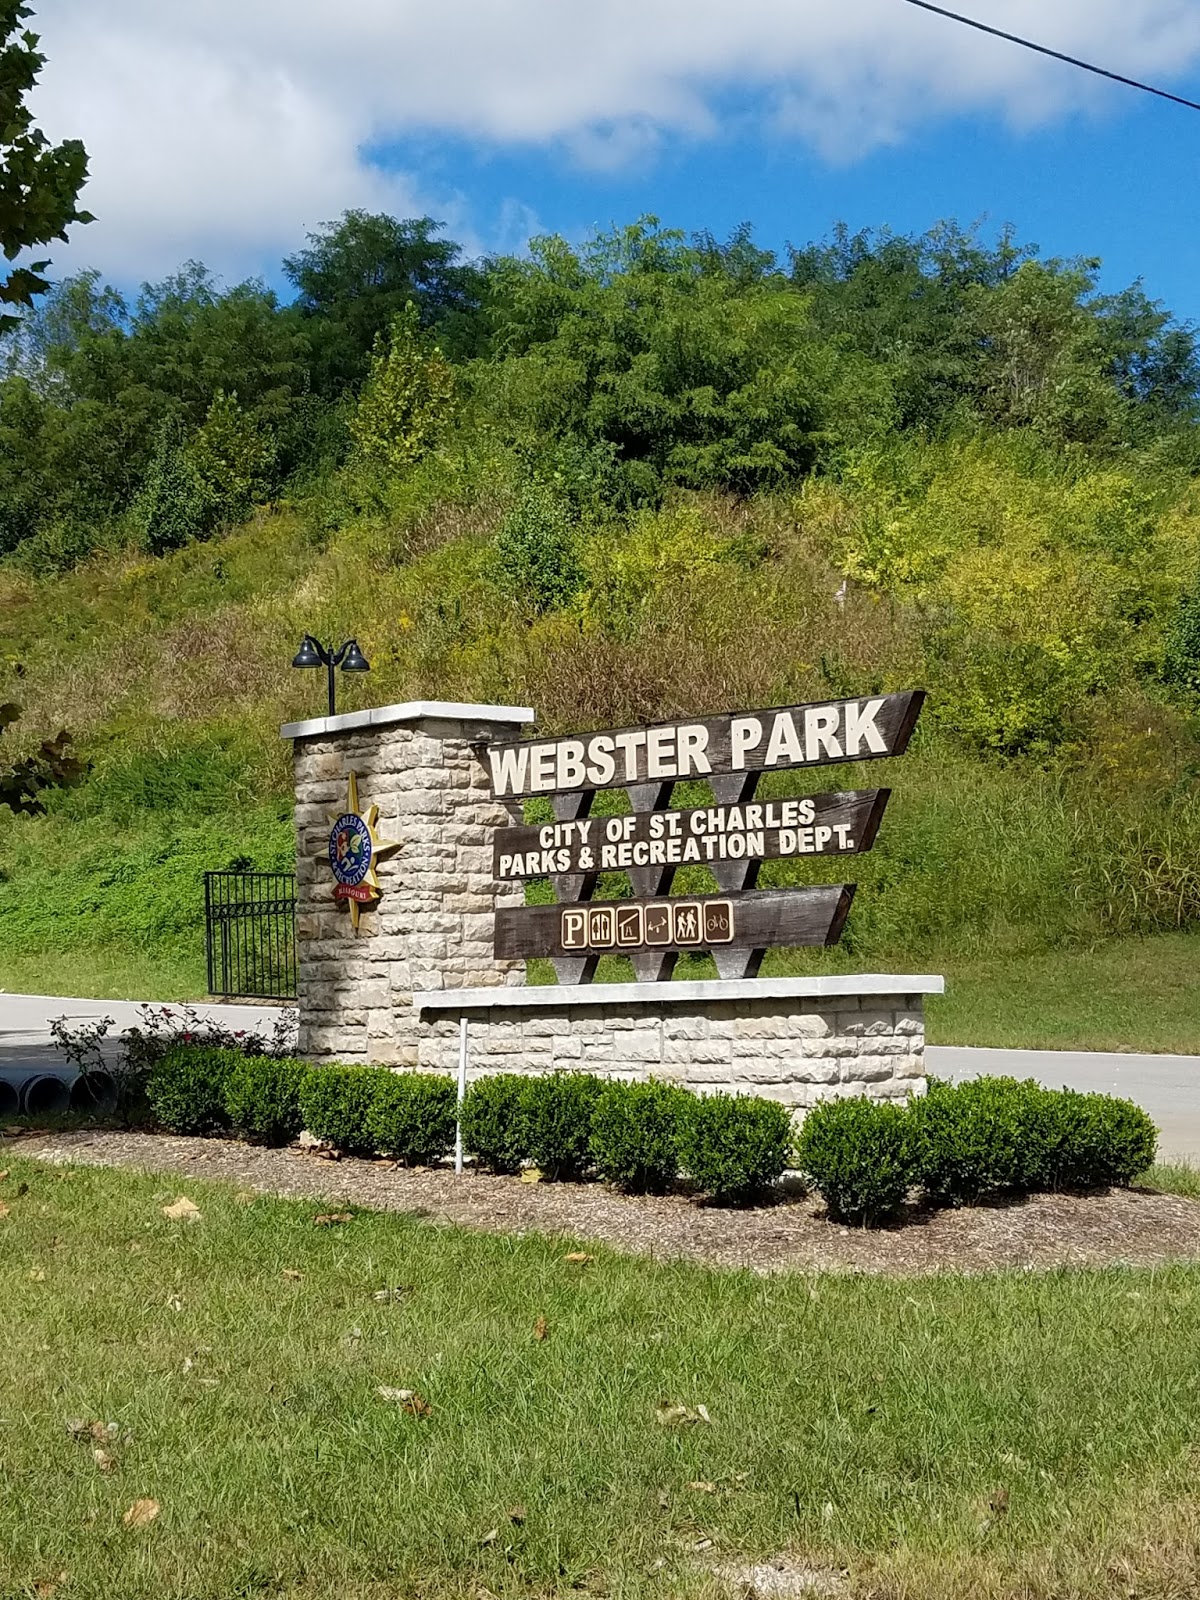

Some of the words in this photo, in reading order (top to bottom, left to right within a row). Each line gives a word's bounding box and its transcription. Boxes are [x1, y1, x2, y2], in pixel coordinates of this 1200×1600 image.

[490, 724, 712, 796] WEBSTER
[731, 699, 888, 770] PARK
[332, 815, 357, 840] CHARLES
[356, 819, 371, 853] PARKS
[539, 819, 592, 849] CITY
[606, 816, 637, 842] OF
[650, 812, 681, 839] ST.
[690, 799, 816, 834] CHARLES
[499, 847, 571, 878] PARKS
[578, 845, 595, 870] &
[602, 831, 764, 869] RECREATION
[779, 823, 855, 854] DEPT.
[335, 857, 369, 886] RECREATION
[338, 887, 367, 900] MISSOURI
[564, 914, 583, 945] P
